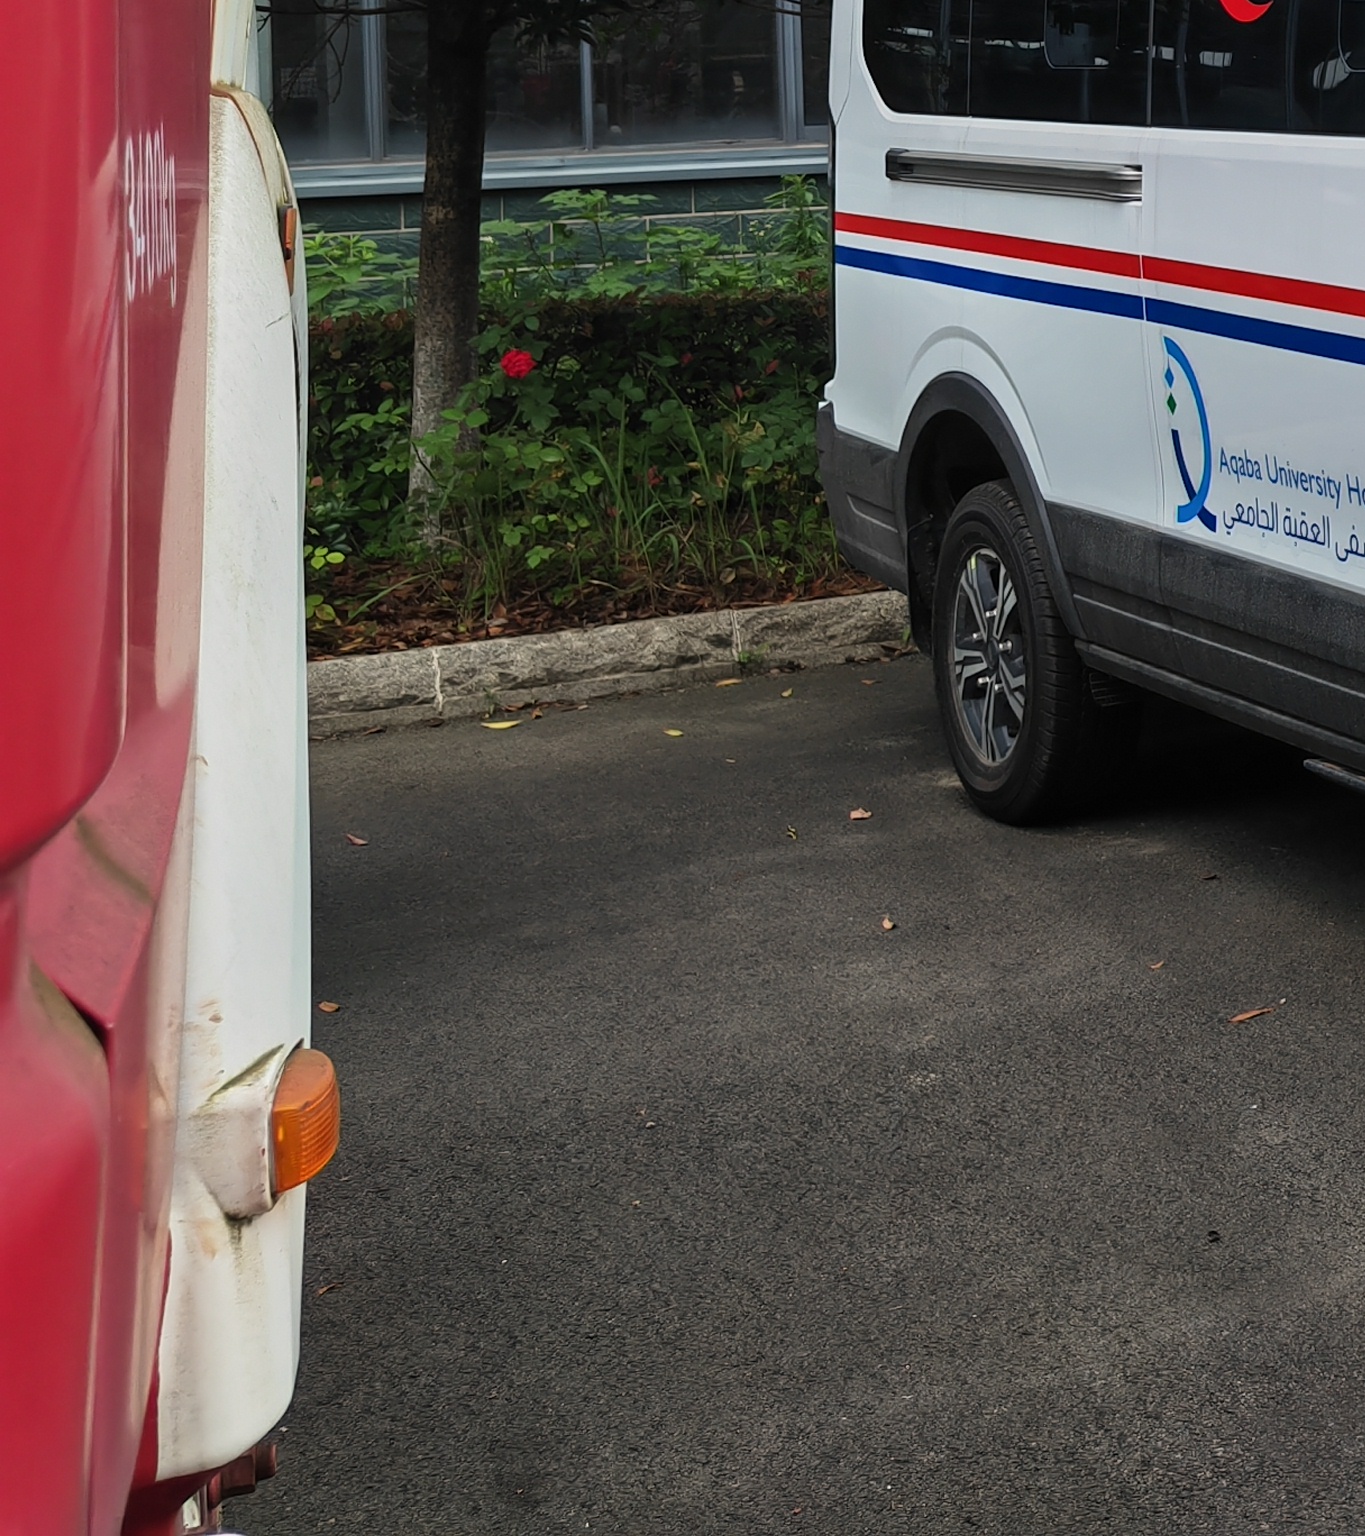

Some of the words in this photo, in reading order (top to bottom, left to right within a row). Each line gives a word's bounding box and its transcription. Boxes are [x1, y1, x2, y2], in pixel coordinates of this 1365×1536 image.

[1220, 447, 1262, 484] Aqaba
[1265, 454, 1341, 509] University
[1283, 507, 1331, 548] العقبة
